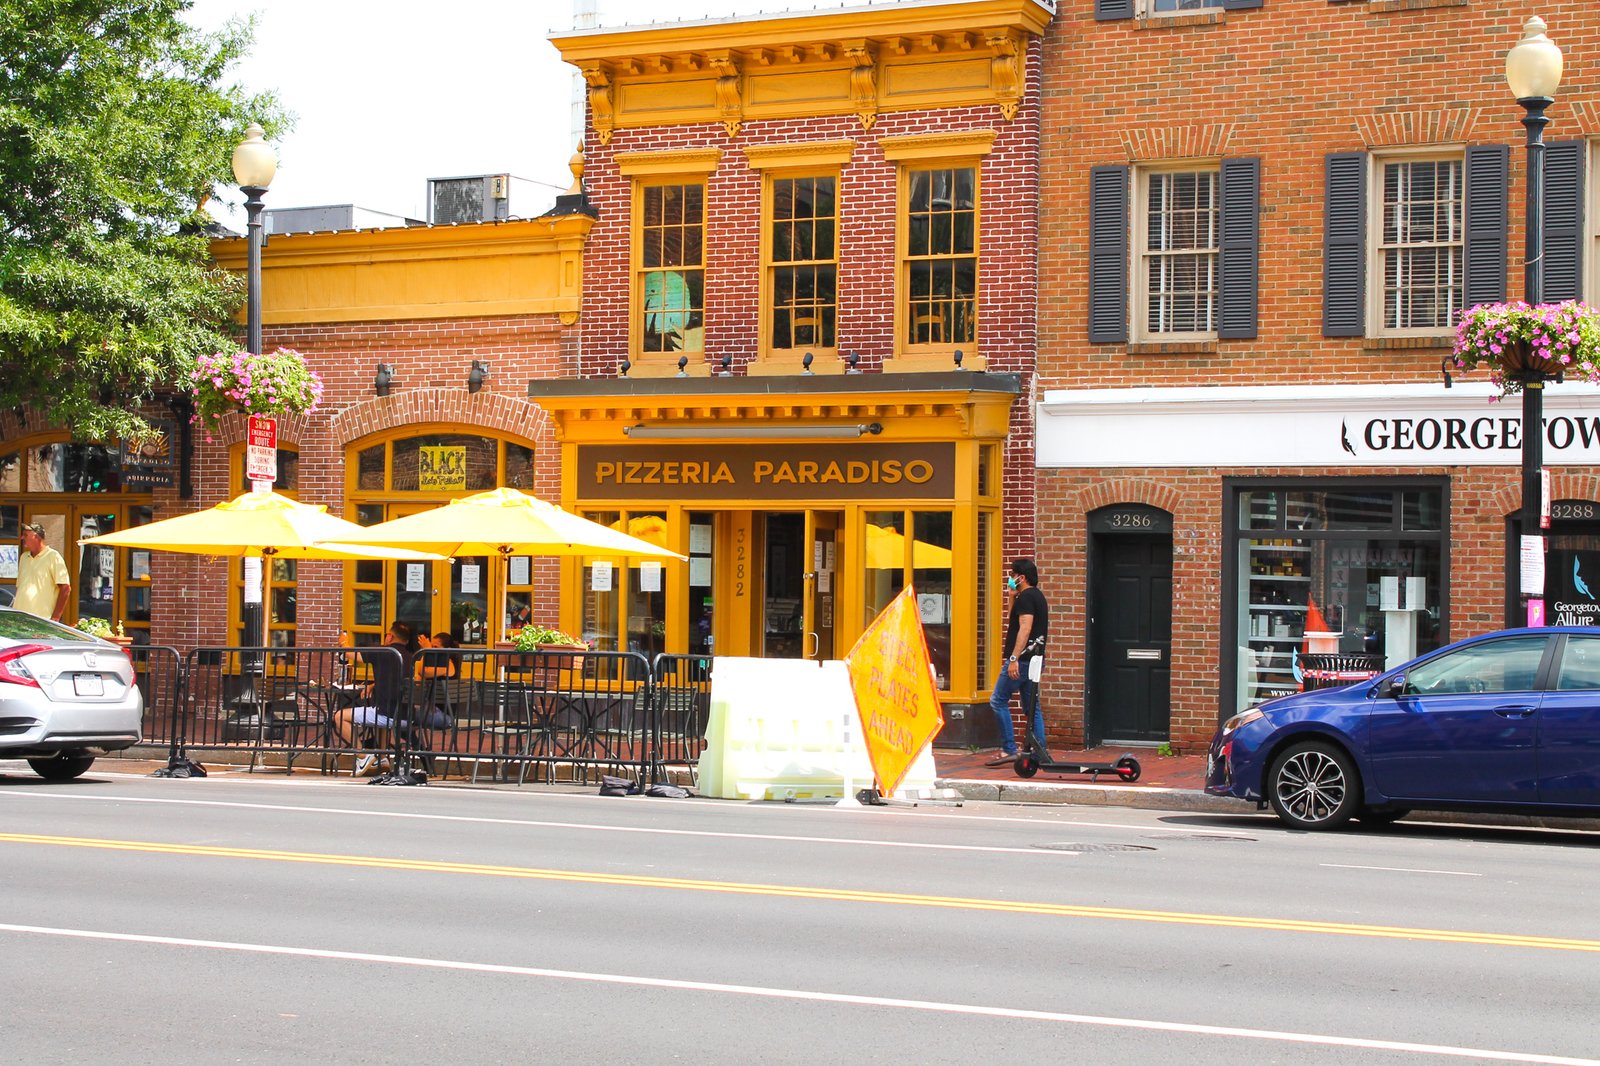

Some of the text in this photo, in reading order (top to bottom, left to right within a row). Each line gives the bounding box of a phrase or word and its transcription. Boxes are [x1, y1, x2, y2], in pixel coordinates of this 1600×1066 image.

[251, 428, 273, 438] EMERGENCY
[255, 419, 271, 430] SNOW
[1364, 416, 1600, 450] GEORGEOW
[251, 446, 273, 457] NO PARKING
[254, 436, 270, 447] ROUTE
[420, 450, 465, 475] BLACK
[595, 459, 934, 484] PIZZERIA PARADISO
[1112, 514, 1151, 527] 3286
[1552, 504, 1594, 518] 3288
[735, 527, 745, 597] 3282
[1555, 611, 1594, 626] Allure
[880, 631, 917, 677] STEEL
[868, 665, 919, 719] PLATES
[868, 709, 914, 756] AHEAD
